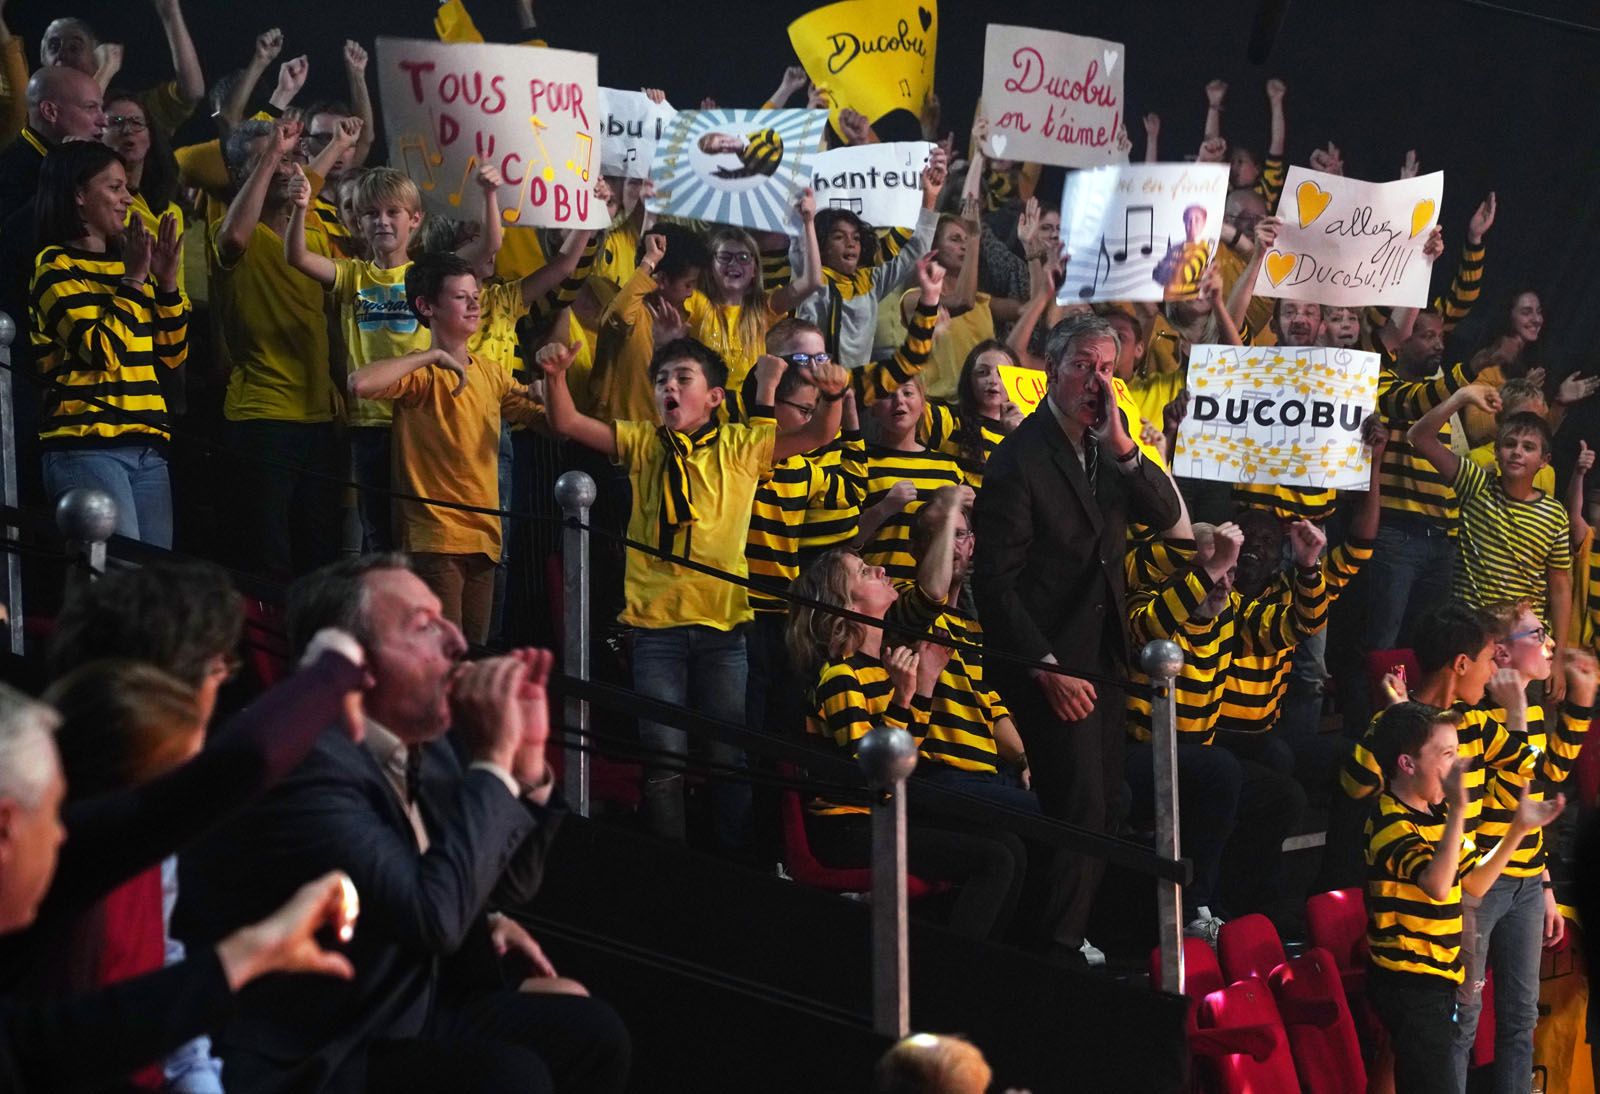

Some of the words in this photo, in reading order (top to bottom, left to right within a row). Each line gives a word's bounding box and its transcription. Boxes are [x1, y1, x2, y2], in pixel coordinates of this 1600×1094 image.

[827, 19, 927, 74] Ducobu
[400, 60, 506, 114] TOUS
[530, 79, 589, 130] POUR
[1004, 46, 1117, 107] Ducobu
[995, 112, 1031, 132] on
[438, 113, 589, 222] DUCOBU
[809, 167, 923, 191] hanteu
[1325, 206, 1403, 264] allez
[1193, 395, 1363, 431] DUCOBU
